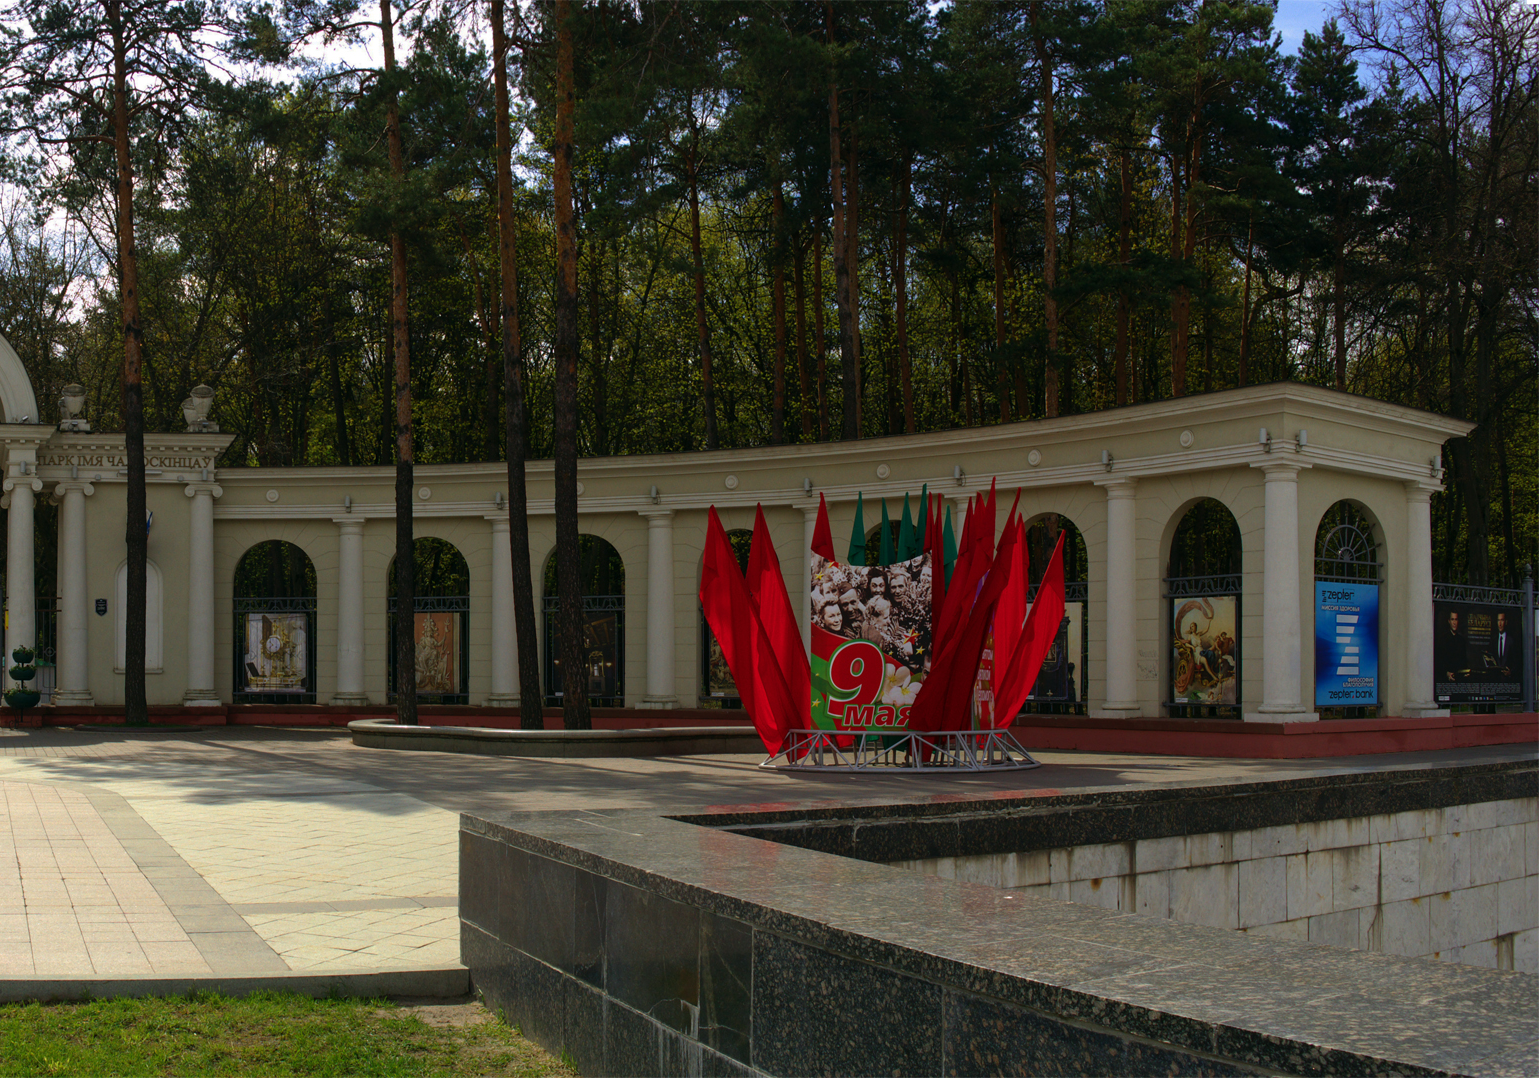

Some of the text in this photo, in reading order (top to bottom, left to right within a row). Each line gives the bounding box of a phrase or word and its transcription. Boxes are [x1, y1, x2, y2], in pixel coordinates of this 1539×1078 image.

[37, 456, 212, 469] ПАРК ІМЯ ЧАСКІНЦАЎ
[1327, 588, 1355, 603] zepter
[827, 641, 885, 717] 9
[1328, 689, 1374, 700] zepter bank
